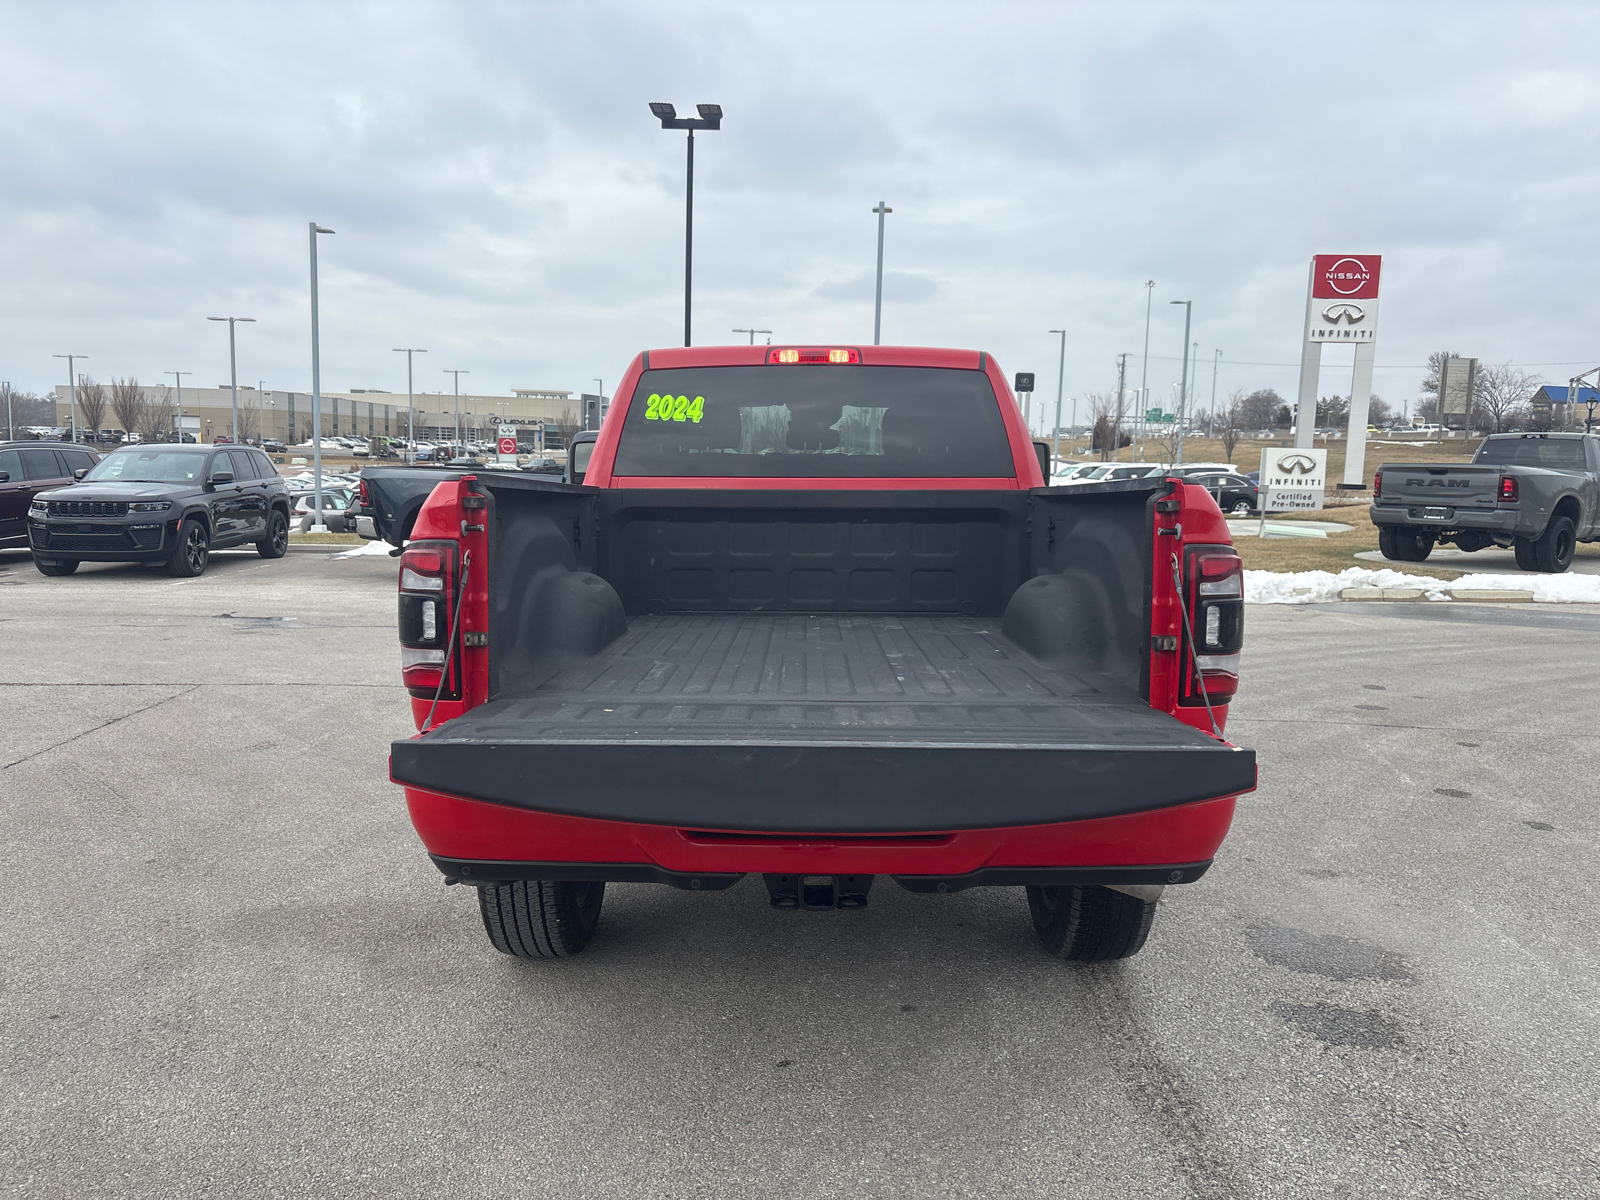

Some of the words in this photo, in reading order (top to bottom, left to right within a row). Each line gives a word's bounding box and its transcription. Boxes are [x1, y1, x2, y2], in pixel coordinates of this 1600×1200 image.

[1325, 272, 1370, 280] NISSAN
[1311, 329, 1373, 338] INFINITI
[645, 393, 705, 423] 2024
[1269, 478, 1321, 486] INFINITI
[1405, 478, 1470, 488] RAM
